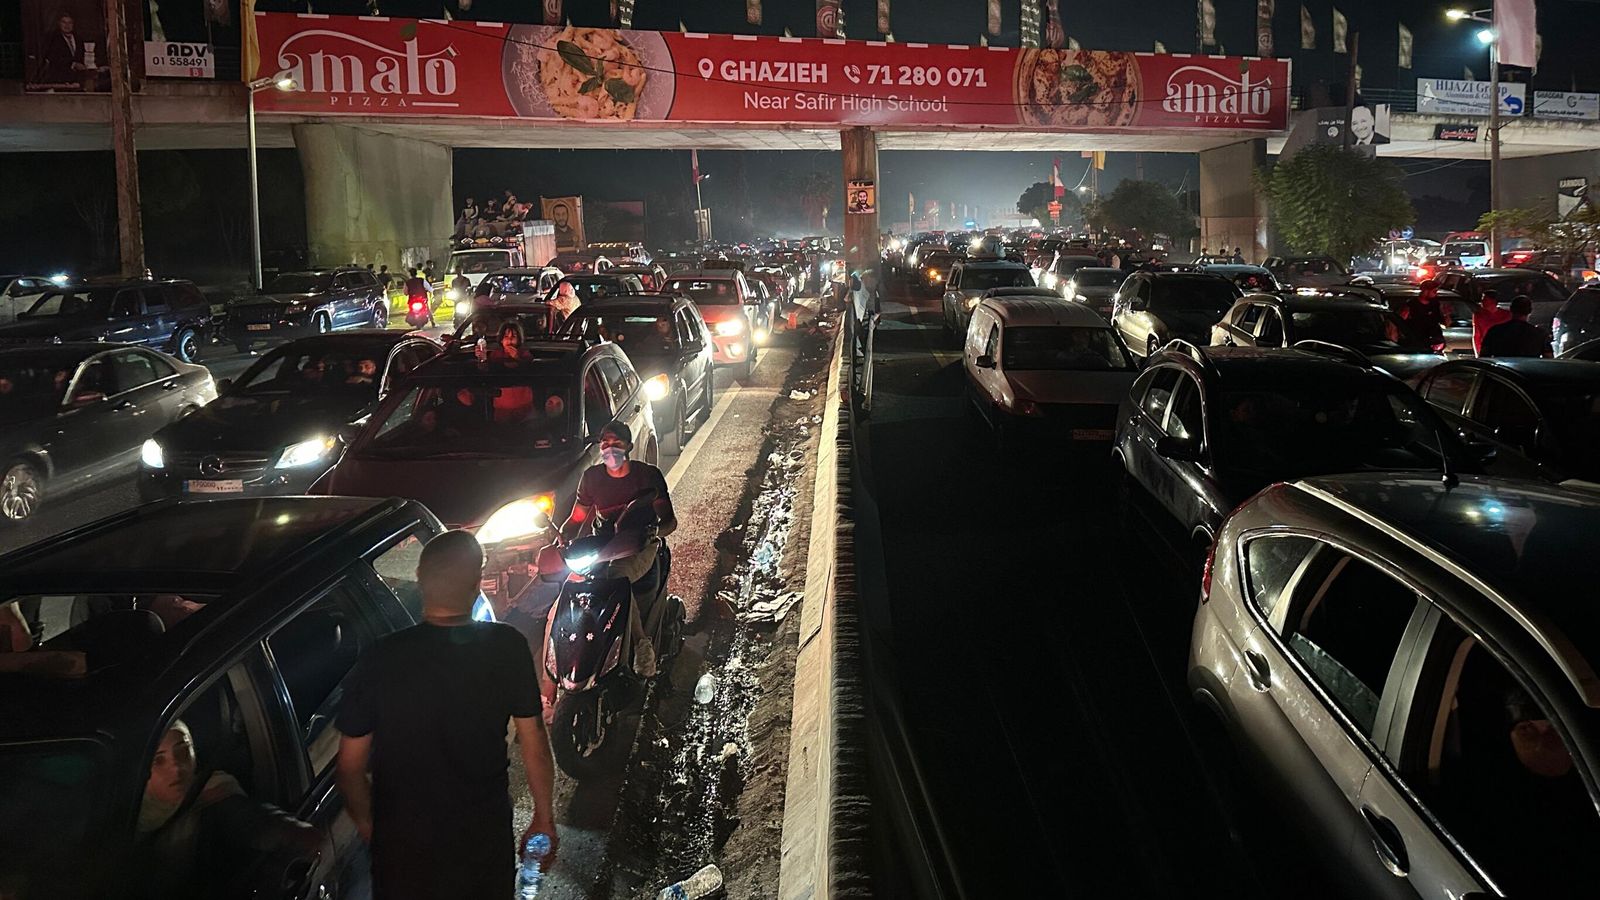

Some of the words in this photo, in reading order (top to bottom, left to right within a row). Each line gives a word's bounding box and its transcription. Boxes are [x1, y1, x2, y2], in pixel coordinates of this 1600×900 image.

[166, 44, 207, 57] ADV
[152, 57, 165, 65] 01
[169, 57, 208, 66] 558491
[720, 60, 828, 83] GHAZIEH
[866, 64, 893, 85] 71
[898, 65, 941, 86] 280
[946, 68, 987, 87] 071
[1436, 80, 1473, 92] HIJAZI
[1476, 82, 1508, 96] Grup
[330, 96, 407, 107] PIZZA
[744, 91, 790, 110] Near
[794, 91, 836, 110] Safir
[841, 94, 882, 114] High
[889, 95, 948, 112] School
[1195, 114, 1240, 123] PIZZA
